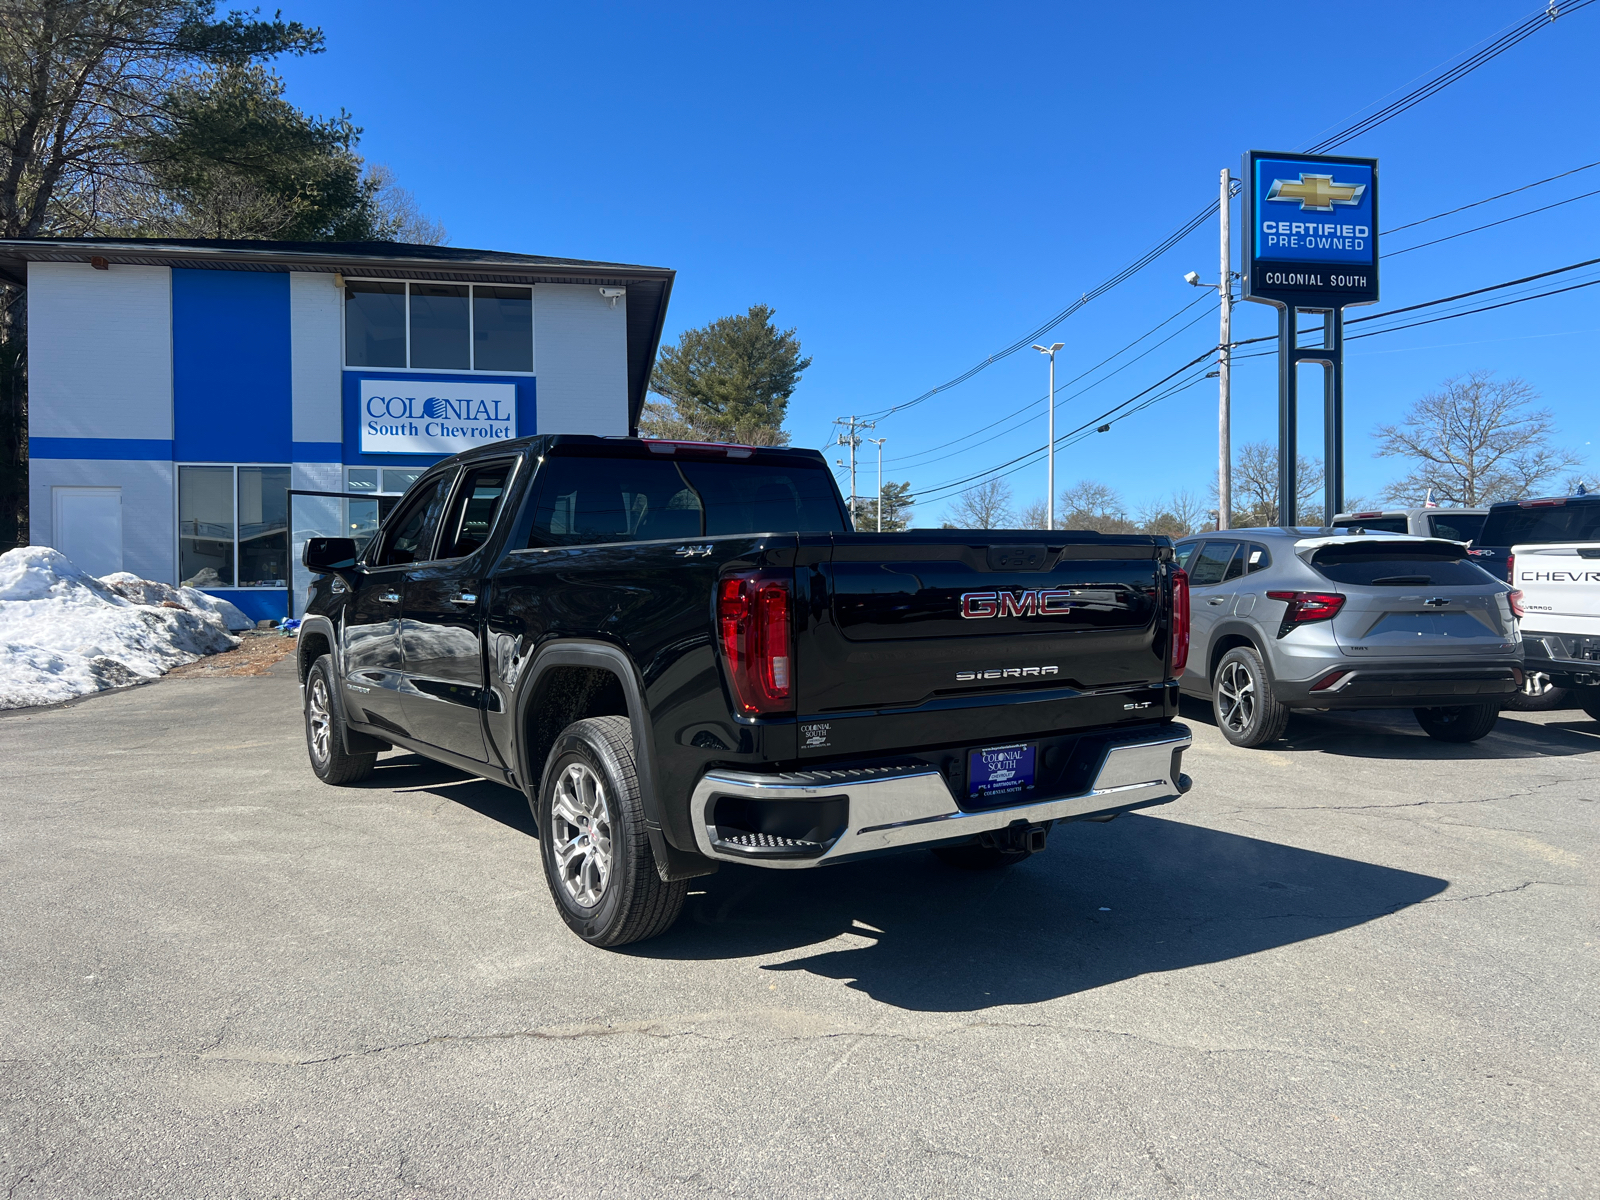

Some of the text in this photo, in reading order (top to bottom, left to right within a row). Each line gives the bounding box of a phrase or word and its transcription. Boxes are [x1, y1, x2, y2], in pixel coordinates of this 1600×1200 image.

[1263, 221, 1369, 238] CERTIFIED
[1268, 235, 1364, 250] PRE-OWNED
[1266, 272, 1367, 287] COLONIAL SOUTH
[366, 396, 511, 422] COLONIAL
[367, 420, 511, 439] South Chevrolet
[960, 589, 1071, 620] GMC
[955, 665, 1059, 681] SIERRA
[1123, 701, 1152, 711] SLT
[801, 723, 831, 732] COLONIAL
[805, 730, 827, 738] SOUTH
[983, 751, 1023, 763] COLONIAL
[988, 760, 1016, 772] SOUTH
